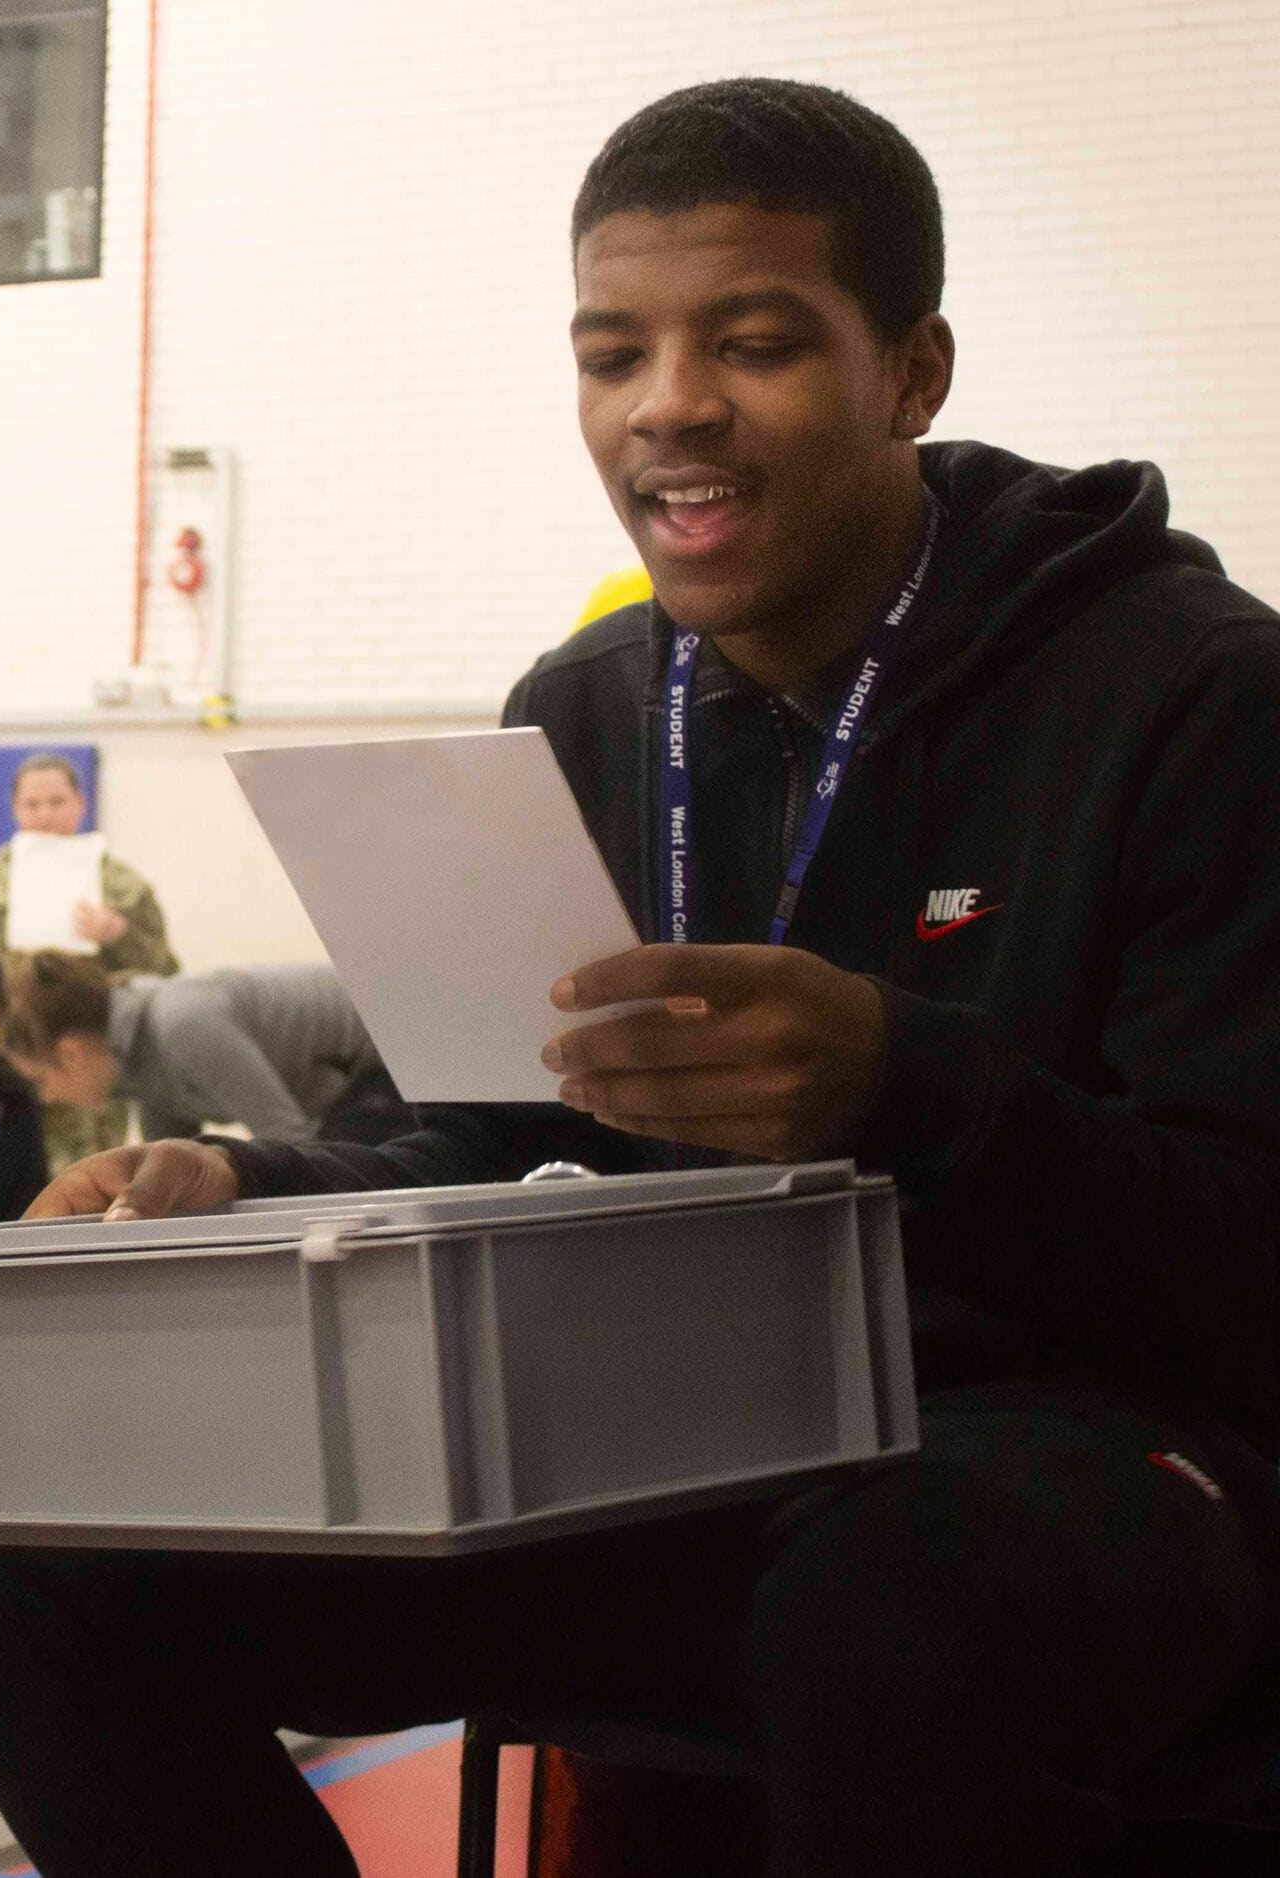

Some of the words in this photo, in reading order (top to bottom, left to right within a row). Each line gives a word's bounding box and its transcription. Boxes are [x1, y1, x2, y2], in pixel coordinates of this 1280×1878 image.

[885, 590, 914, 625] West
[906, 544, 932, 590] London
[670, 685, 684, 769] STUDENT
[835, 657, 880, 741] STUDENT
[671, 806, 686, 845] West
[671, 851, 686, 908] London
[925, 888, 981, 922] NIKE
[672, 912, 687, 944] Coll
